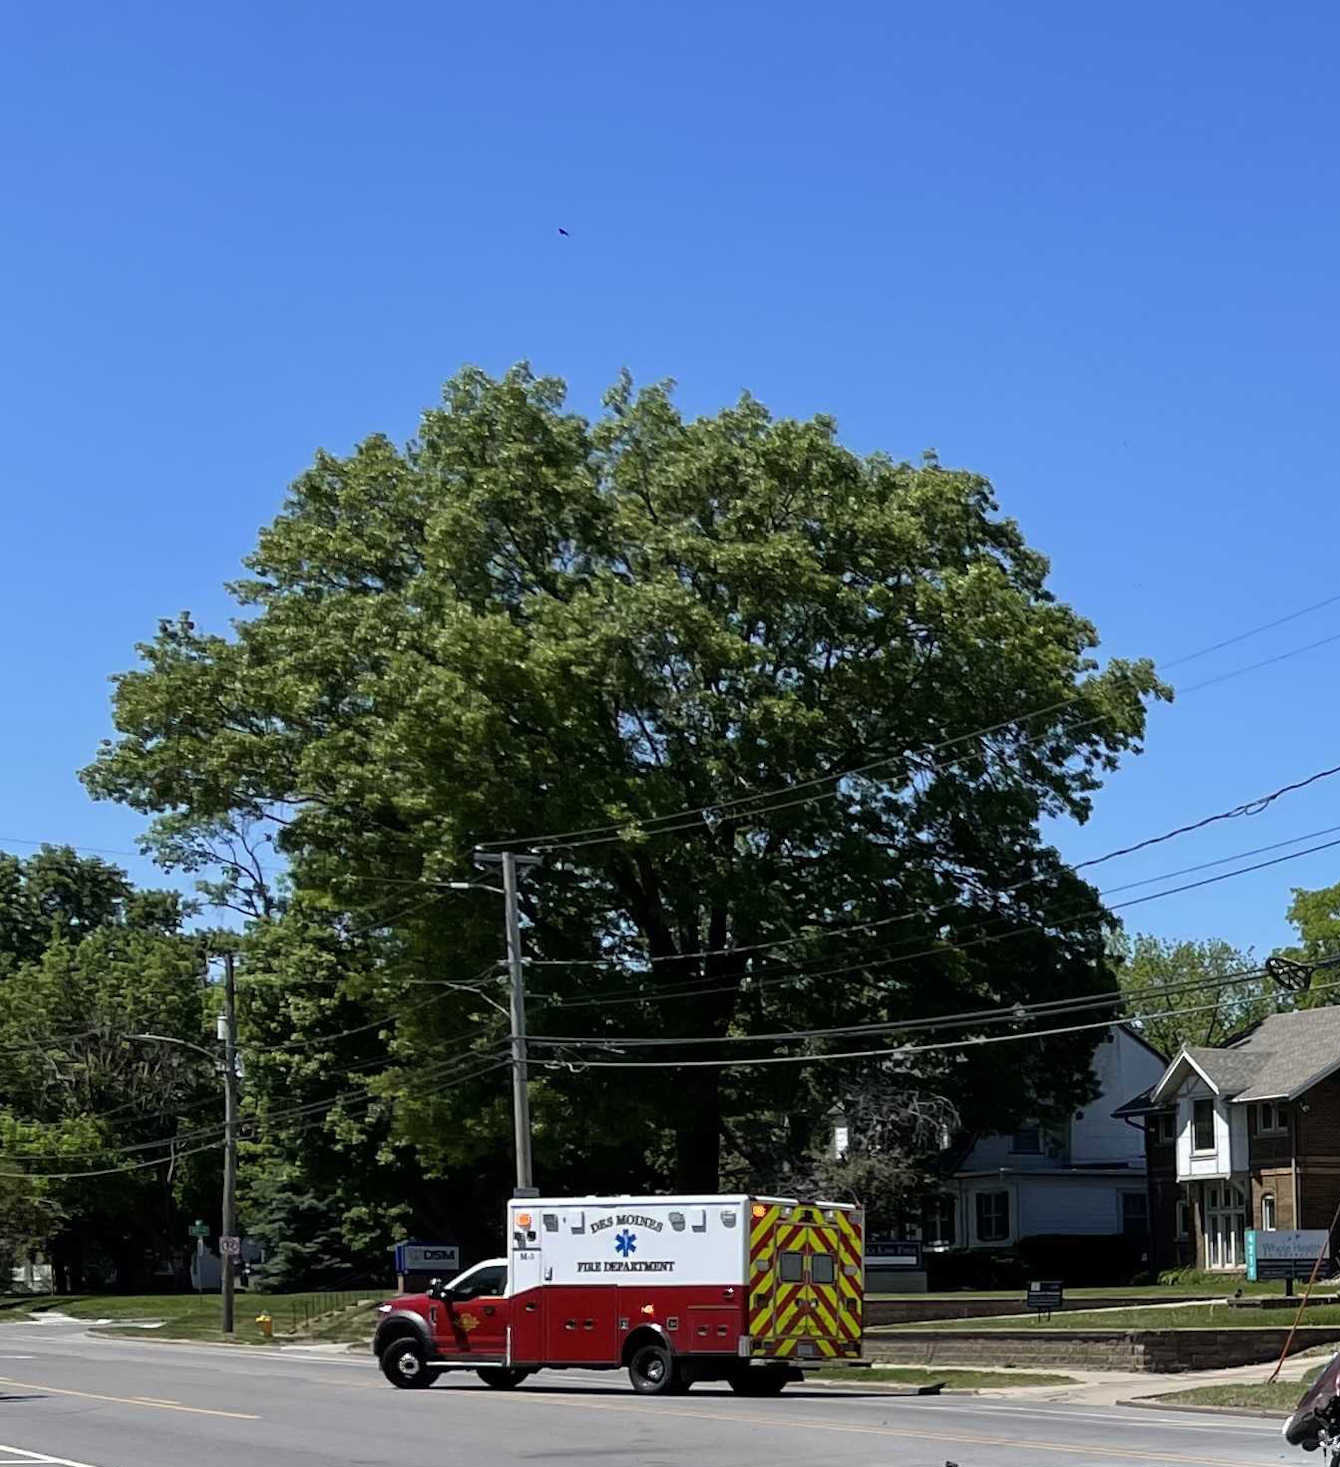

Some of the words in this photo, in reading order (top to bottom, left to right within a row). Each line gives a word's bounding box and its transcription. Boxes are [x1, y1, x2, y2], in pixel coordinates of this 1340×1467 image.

[590, 1216, 613, 1234] DES
[616, 1214, 664, 1233] MOINES
[577, 1261, 601, 1272] FIRE
[603, 1261, 675, 1272] DEPARTMENT
